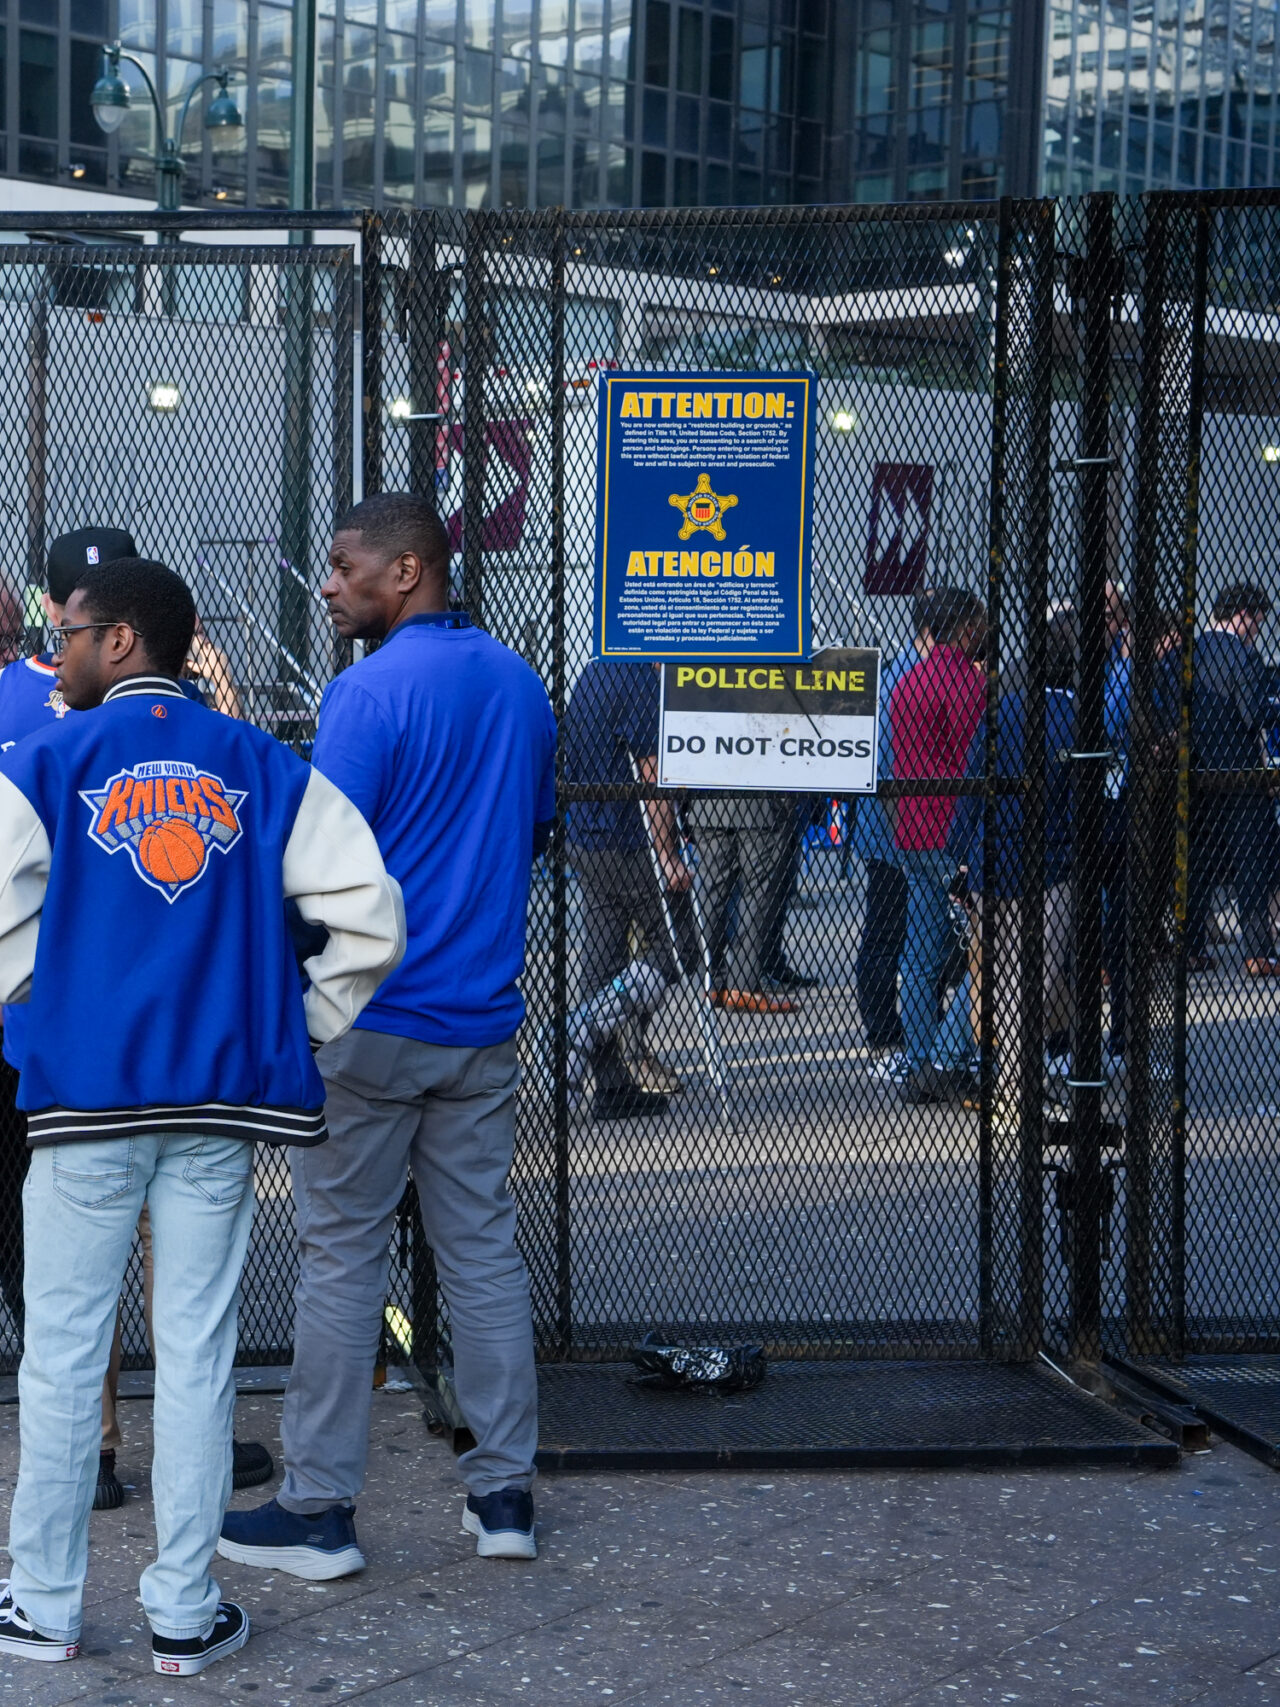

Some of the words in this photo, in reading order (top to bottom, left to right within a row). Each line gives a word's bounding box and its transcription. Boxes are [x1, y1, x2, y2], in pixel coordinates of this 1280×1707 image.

[620, 392, 795, 419] ATTENTION:
[626, 545, 775, 577] ATENCIÓN
[677, 667, 785, 690] POLICE
[795, 670, 865, 691] LINE
[667, 736, 706, 753] DO
[715, 737, 772, 756] NOT
[780, 738, 871, 758] CROSS
[137, 763, 161, 776] NEW
[164, 763, 195, 777] YORK
[97, 777, 238, 834] KNICKS
